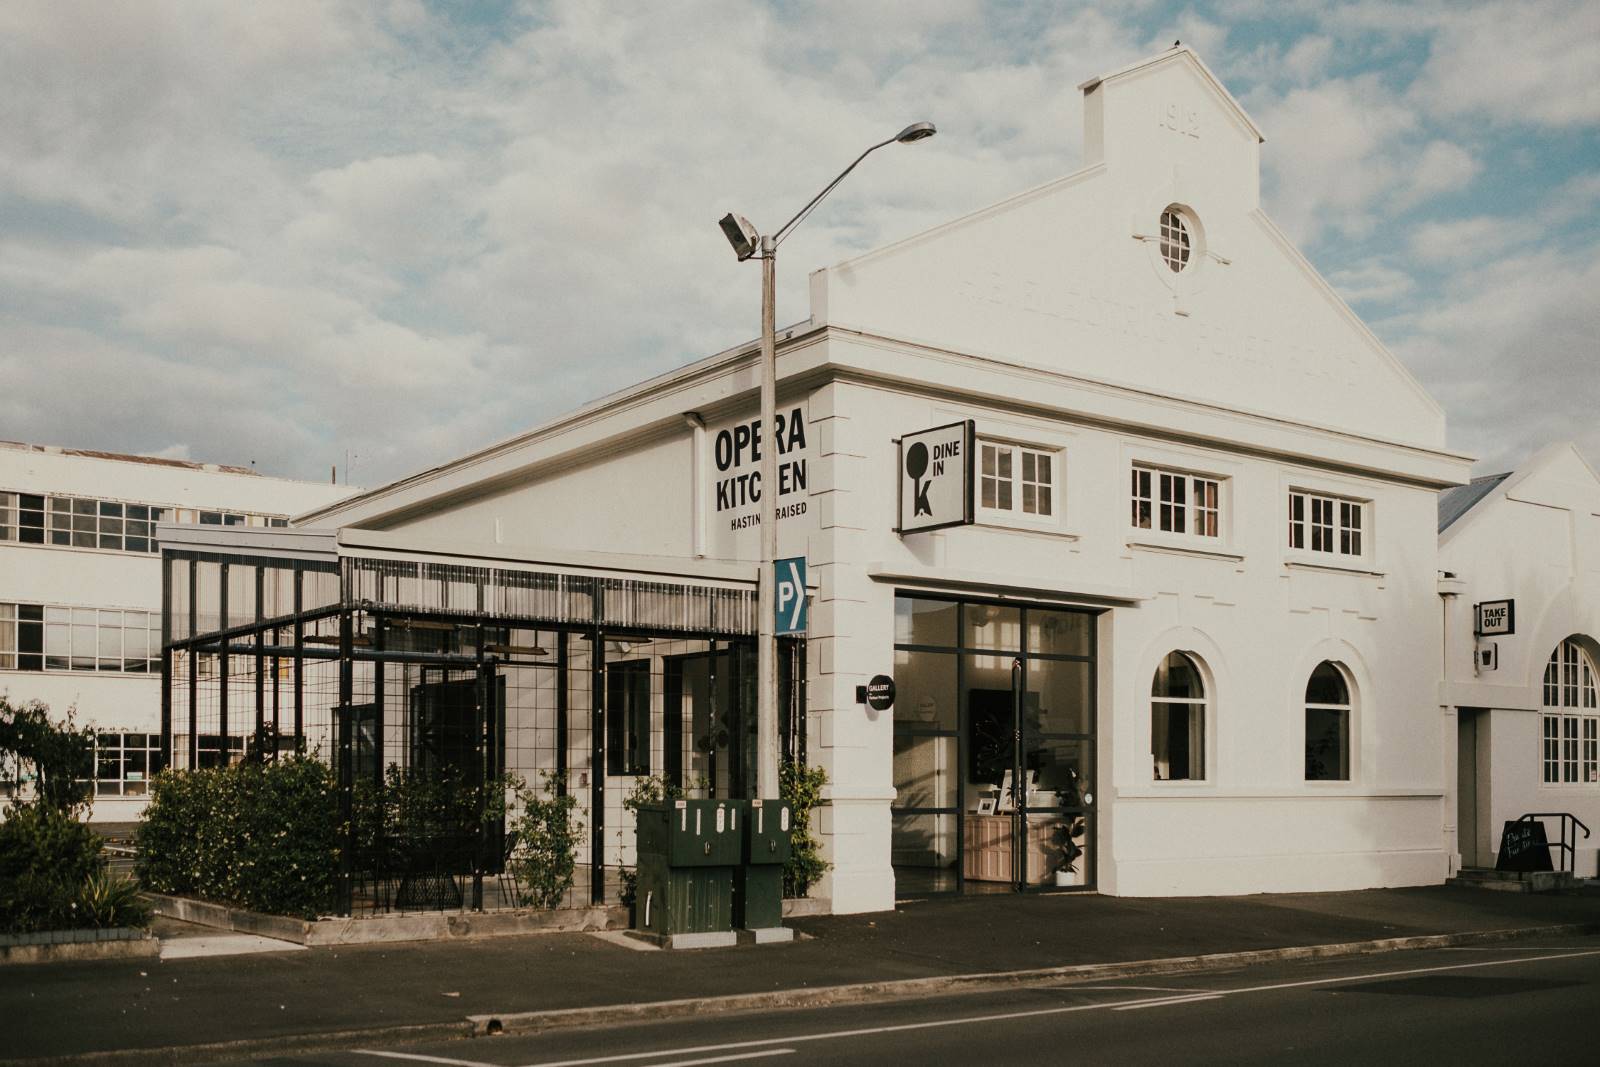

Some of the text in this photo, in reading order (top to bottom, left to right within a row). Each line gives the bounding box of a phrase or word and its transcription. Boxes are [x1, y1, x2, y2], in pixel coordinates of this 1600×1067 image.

[933, 441, 960, 460] DINE
[933, 460, 944, 477] IN
[716, 459, 806, 511] KITCEN
[731, 501, 807, 531] HASTIN RAISED
[779, 581, 794, 612] P
[1484, 607, 1506, 618] TAKE
[1484, 617, 1502, 627] OUT
